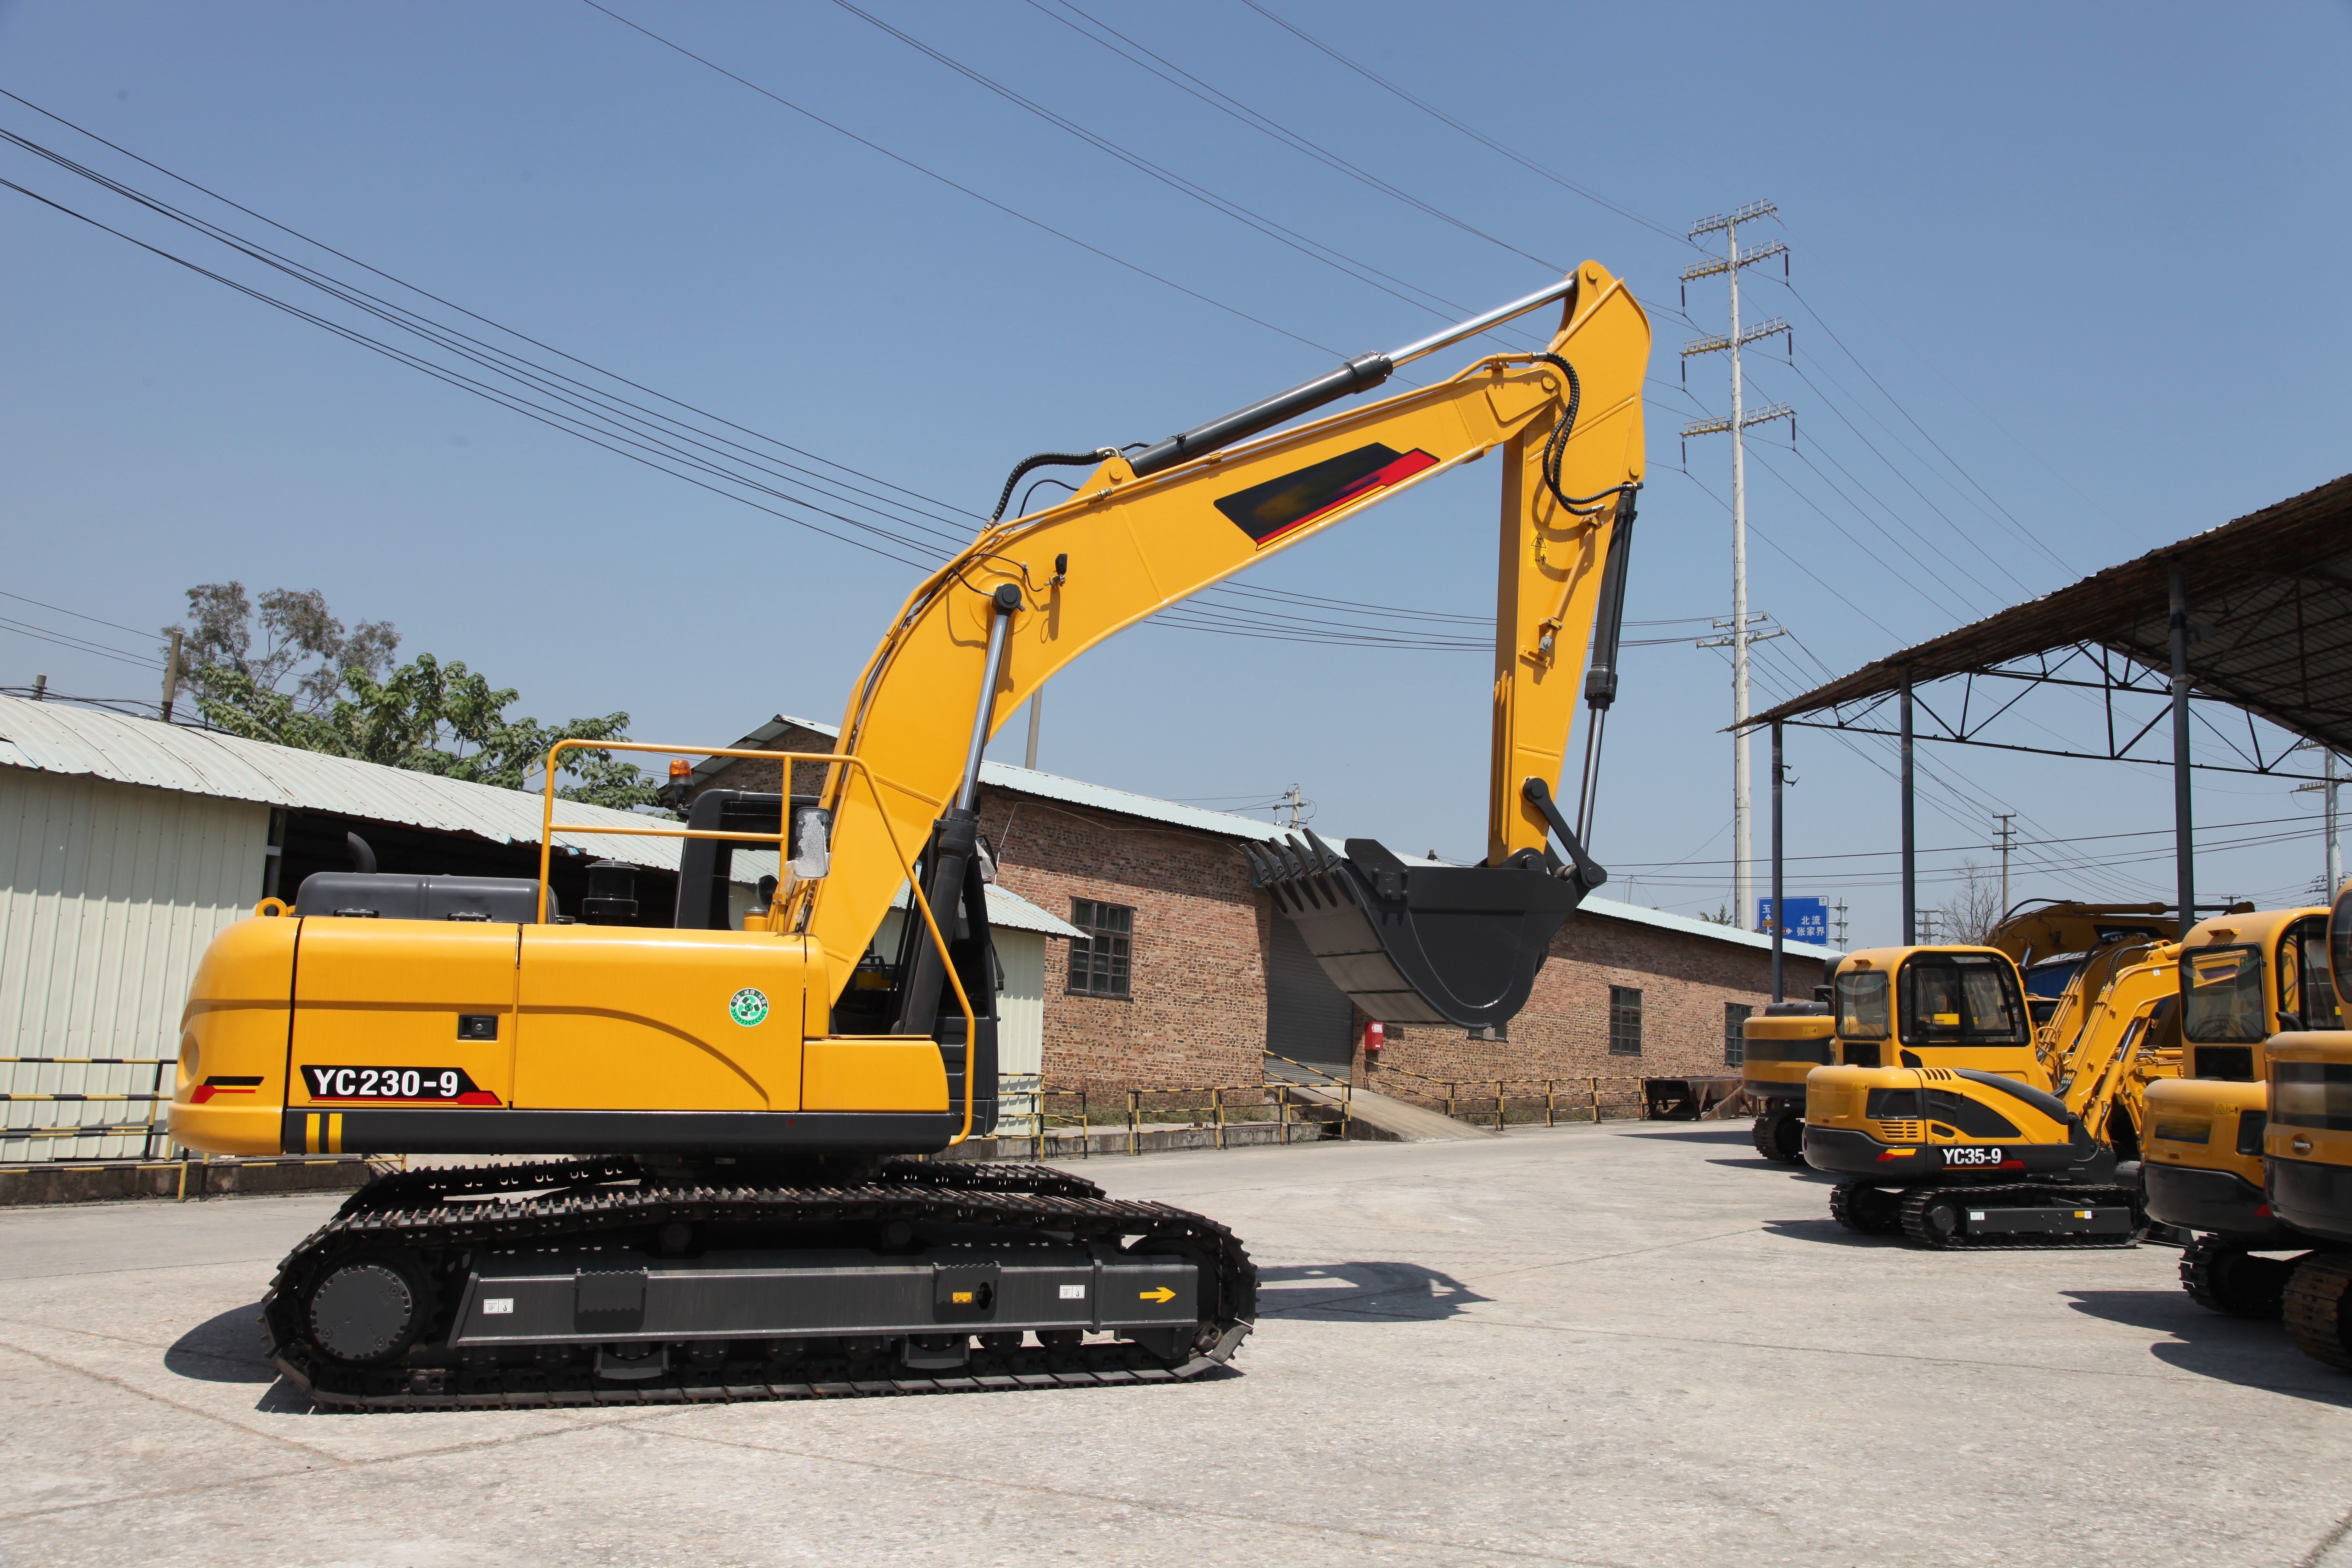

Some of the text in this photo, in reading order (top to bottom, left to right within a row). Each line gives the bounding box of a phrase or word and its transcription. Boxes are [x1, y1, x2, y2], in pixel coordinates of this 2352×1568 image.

[1801, 916, 1821, 925] 北流
[1797, 926, 1825, 936] 张家界
[314, 1069, 458, 1096] YC230-9
[1942, 1148, 2001, 1164] YC35-9
